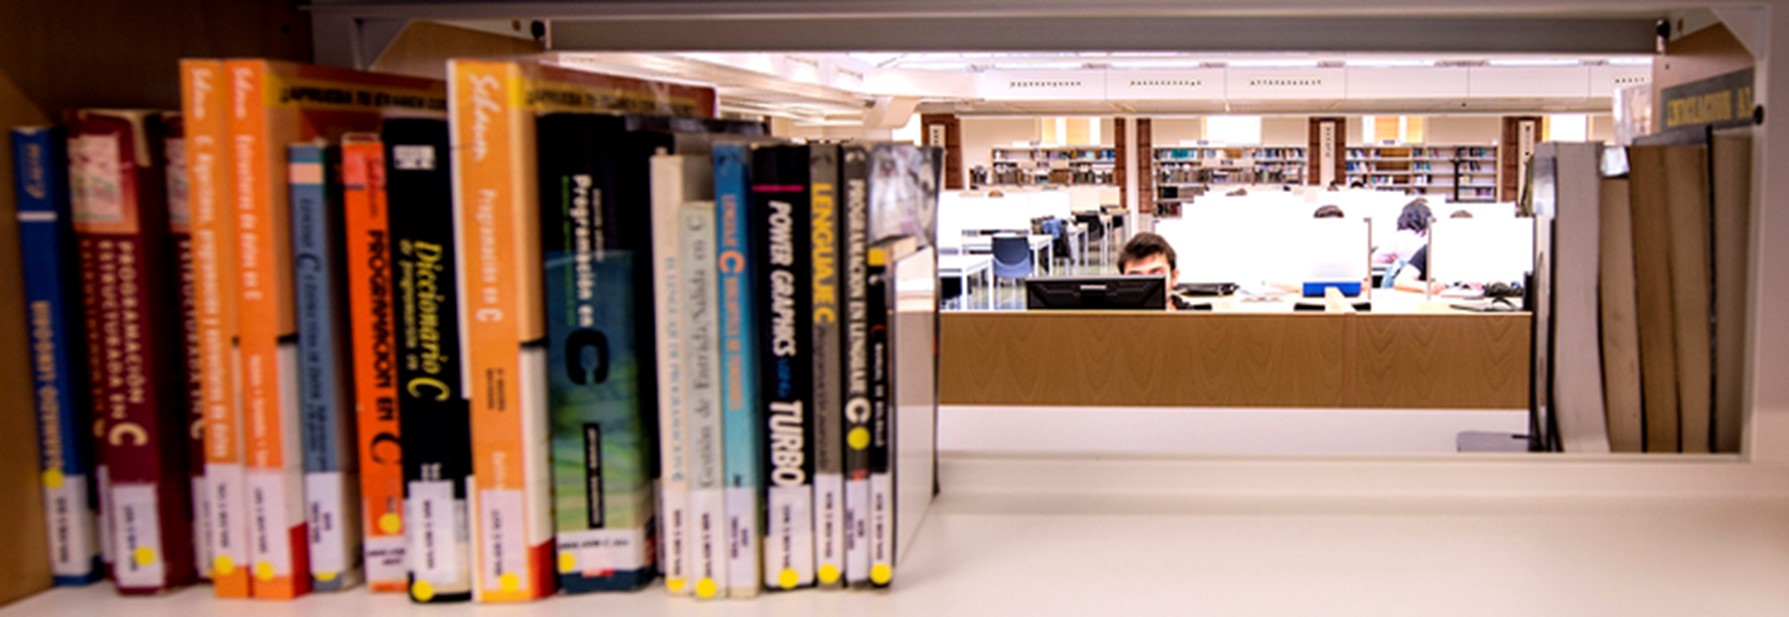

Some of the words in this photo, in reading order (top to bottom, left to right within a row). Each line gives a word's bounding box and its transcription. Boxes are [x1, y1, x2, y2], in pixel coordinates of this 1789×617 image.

[467, 73, 502, 162] Schaum
[475, 188, 499, 283] Programación
[568, 174, 594, 300] Programación
[717, 249, 745, 274] C
[768, 199, 794, 266] POWER
[812, 181, 834, 304] LENGUAJE
[847, 179, 866, 299] PROGRAMACION
[98, 239, 125, 386] ESTRUCTURADA
[117, 239, 147, 403] PROGRAMACIÓN
[413, 239, 449, 375] Diccionario
[475, 308, 504, 322] C
[482, 286, 499, 304] en
[577, 304, 594, 328] en
[770, 268, 797, 357] GRAPHICS
[813, 306, 836, 325] C
[849, 300, 867, 320] EN
[564, 328, 610, 386] C
[849, 322, 868, 395] LENGUAJE
[112, 391, 128, 418] EN
[375, 397, 394, 422] EN
[406, 376, 451, 402] C
[844, 396, 872, 425] C
[108, 420, 149, 446] C
[369, 431, 403, 465] C
[768, 399, 806, 486] TURBO
